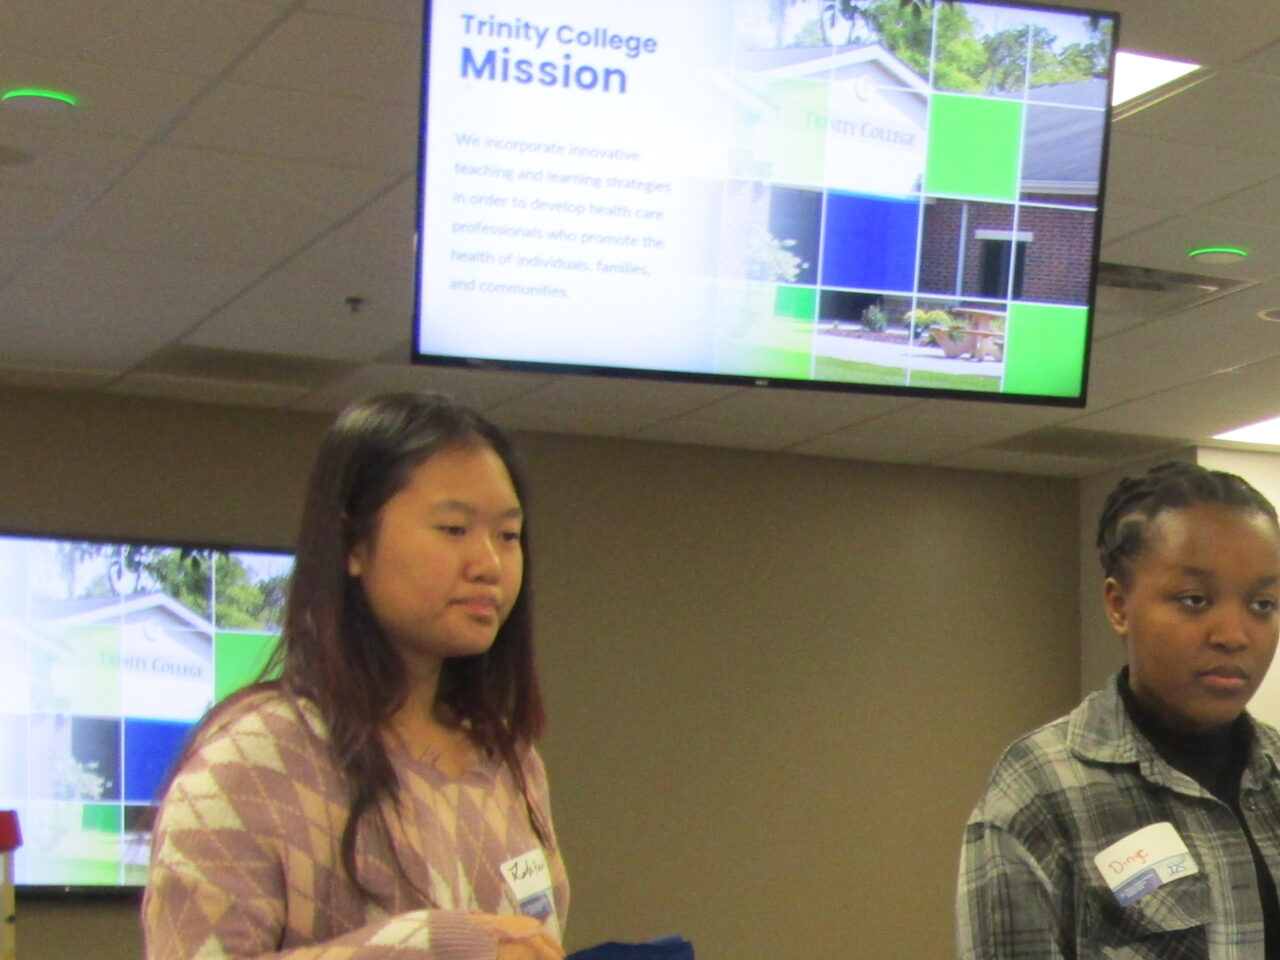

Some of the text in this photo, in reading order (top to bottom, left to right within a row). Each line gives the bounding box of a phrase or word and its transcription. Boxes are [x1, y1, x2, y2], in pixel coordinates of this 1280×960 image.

[460, 13, 658, 59] Trinity College
[460, 47, 627, 93] Mission
[455, 132, 640, 161] We incorporate innovative
[454, 161, 671, 194] teaching and learning strategies
[453, 191, 664, 221] in order to develop health care
[451, 221, 664, 249] professionals who promote the
[450, 248, 494, 264] health
[498, 252, 513, 266] of
[596, 259, 652, 278] families,
[449, 278, 570, 299] and communities.
